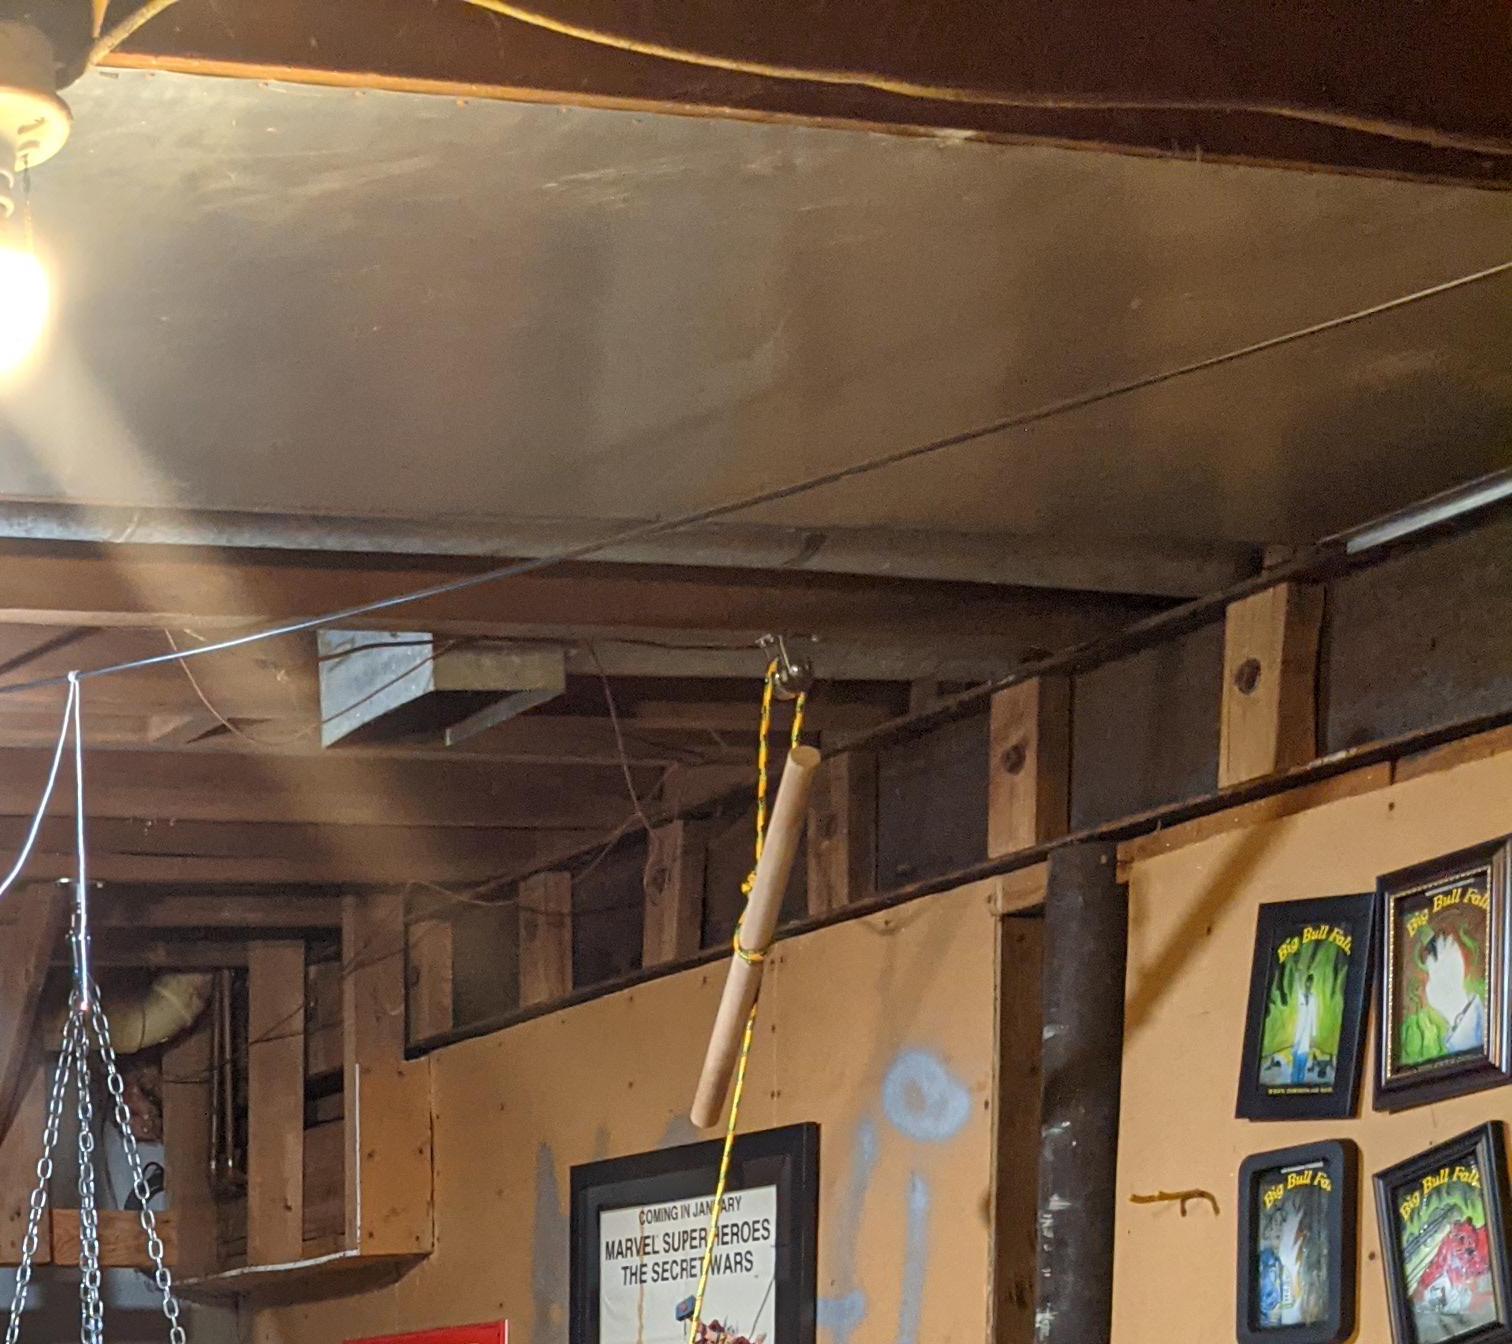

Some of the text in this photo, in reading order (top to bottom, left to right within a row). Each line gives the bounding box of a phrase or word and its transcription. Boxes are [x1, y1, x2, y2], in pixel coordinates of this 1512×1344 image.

[1433, 888, 1463, 912] Bull
[1303, 925, 1329, 944] Bull
[1287, 1170, 1312, 1189] Bull
[1423, 1168, 1449, 1195] Bull
[638, 1195, 742, 1226] COMING IN JANARY
[605, 1233, 659, 1261] MARVEL
[662, 1226, 708, 1253] SUPER
[621, 1250, 754, 1285] THE SECRET WARS
